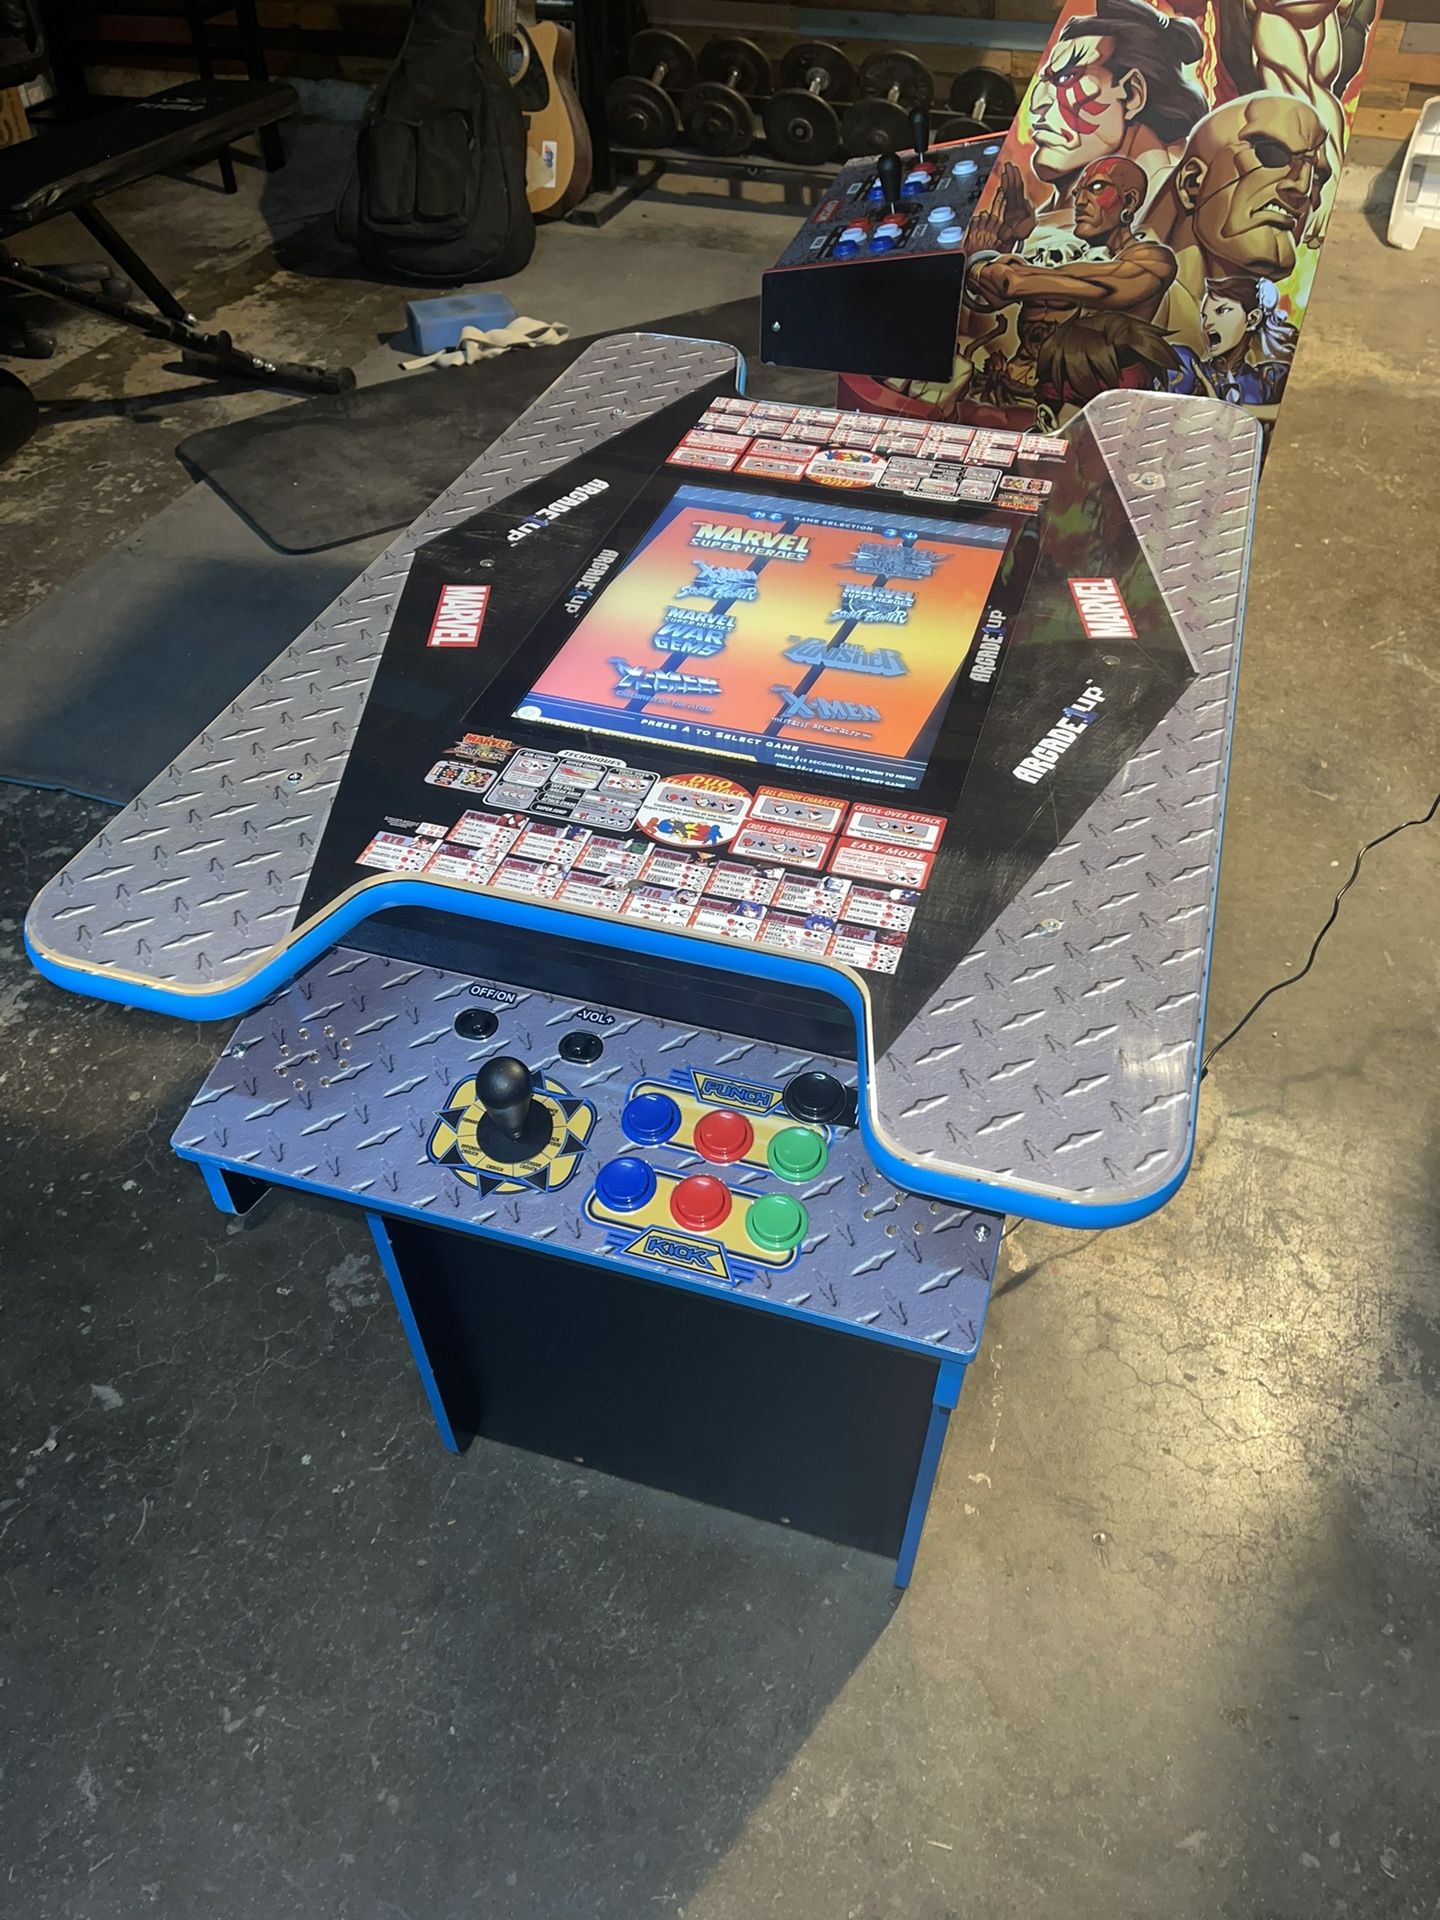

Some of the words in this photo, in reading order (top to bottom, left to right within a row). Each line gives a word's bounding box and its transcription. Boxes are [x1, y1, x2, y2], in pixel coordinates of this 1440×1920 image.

[793, 516, 819, 524] GAME
[822, 519, 874, 531] SELECTION
[692, 521, 811, 553] MARVEL
[690, 537, 741, 552] SUPER
[744, 546, 809, 561] HEROES
[842, 592, 874, 602] SUPER
[875, 597, 914, 607] HEROES
[1072, 578, 1133, 638] MARVEL
[430, 585, 488, 646] MARVEL
[665, 606, 736, 628] MARVEL
[657, 623, 724, 645] WAR
[654, 635, 722, 656] GEMS
[770, 684, 882, 721] X-MEN
[463, 732, 513, 749] MARVEL
[640, 718, 677, 730] PRESS
[682, 725, 690, 733] A
[696, 728, 711, 736] TO
[714, 732, 762, 745] SELECT
[765, 741, 799, 752] GAME
[563, 750, 623, 766] TECHNIQUES
[689, 775, 733, 789] DUO
[760, 788, 778, 796] CALL
[777, 791, 802, 801] BUDDY
[802, 795, 845, 809] CHARACTER
[854, 804, 908, 819] CROSS-OVER
[909, 813, 943, 825] ATTACK
[746, 822, 785, 835] CROSS-OVER
[785, 828, 831, 843] COMBINATION
[850, 841, 926, 860] EASY-MODE
[470, 985, 516, 1002] OFF/ON
[577, 1010, 614, 1024] -VOL+
[703, 1080, 772, 1107] PUNCH
[647, 1236, 718, 1272] KICK
